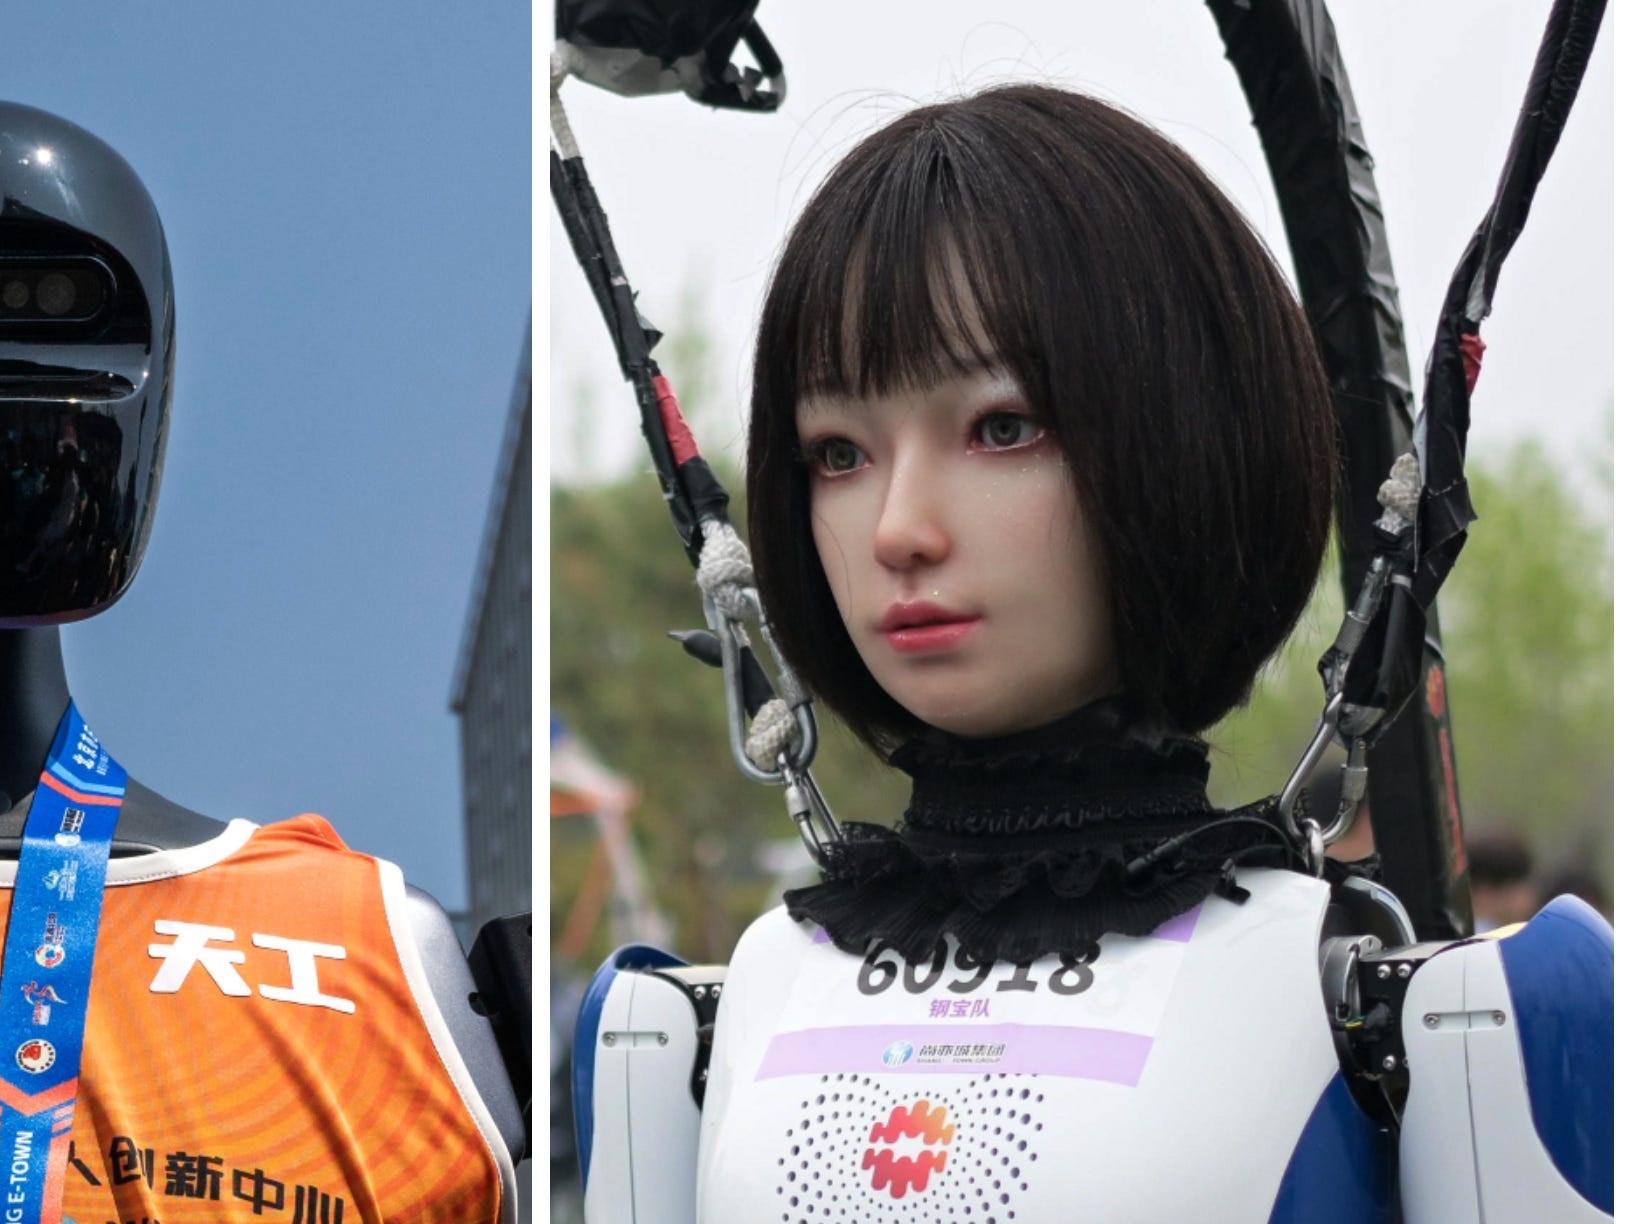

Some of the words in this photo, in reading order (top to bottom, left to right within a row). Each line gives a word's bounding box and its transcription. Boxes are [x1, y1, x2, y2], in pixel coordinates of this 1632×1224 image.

[148, 919, 355, 1014] 天工
[856, 936, 1101, 995] 60918
[928, 998, 990, 1018] 钢宝队
[8, 1130, 33, 1204] E-TOWN
